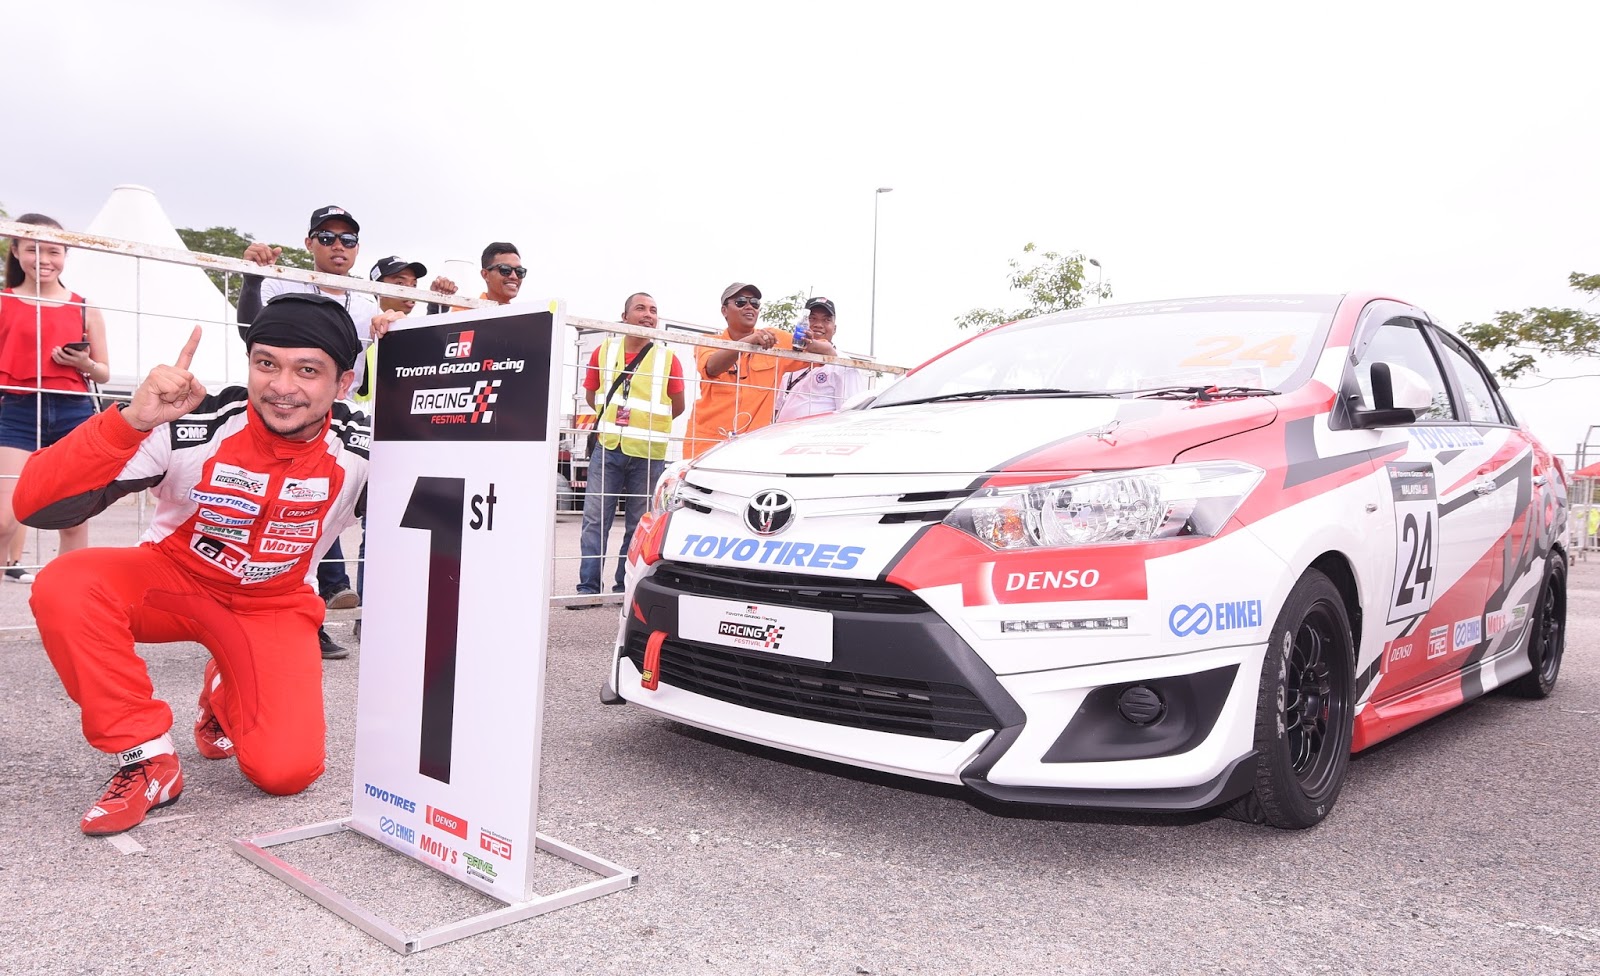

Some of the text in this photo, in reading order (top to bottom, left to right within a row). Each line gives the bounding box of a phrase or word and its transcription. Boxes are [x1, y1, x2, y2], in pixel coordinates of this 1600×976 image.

[445, 341, 472, 357] GR
[1178, 334, 1297, 368] 24
[395, 357, 525, 378] TOYOTA GAZOO Racing
[414, 392, 469, 410] RACING
[431, 414, 467, 425] FESTIVAL
[176, 427, 208, 440] OMP
[349, 433, 370, 447] OM
[287, 508, 318, 517] DENSO
[197, 542, 238, 570] GR
[1396, 511, 1432, 607] 24
[1005, 569, 1100, 592] DENSO
[1215, 599, 1262, 632] ENKEI
[720, 623, 763, 639] RACING
[734, 637, 761, 647] FESTIVAL
[1391, 643, 1413, 663] DENSO
[122, 749, 144, 762] OMP
[435, 814, 457, 830] DENSO
[420, 834, 458, 865] Moty's
[480, 832, 512, 861] TRD
